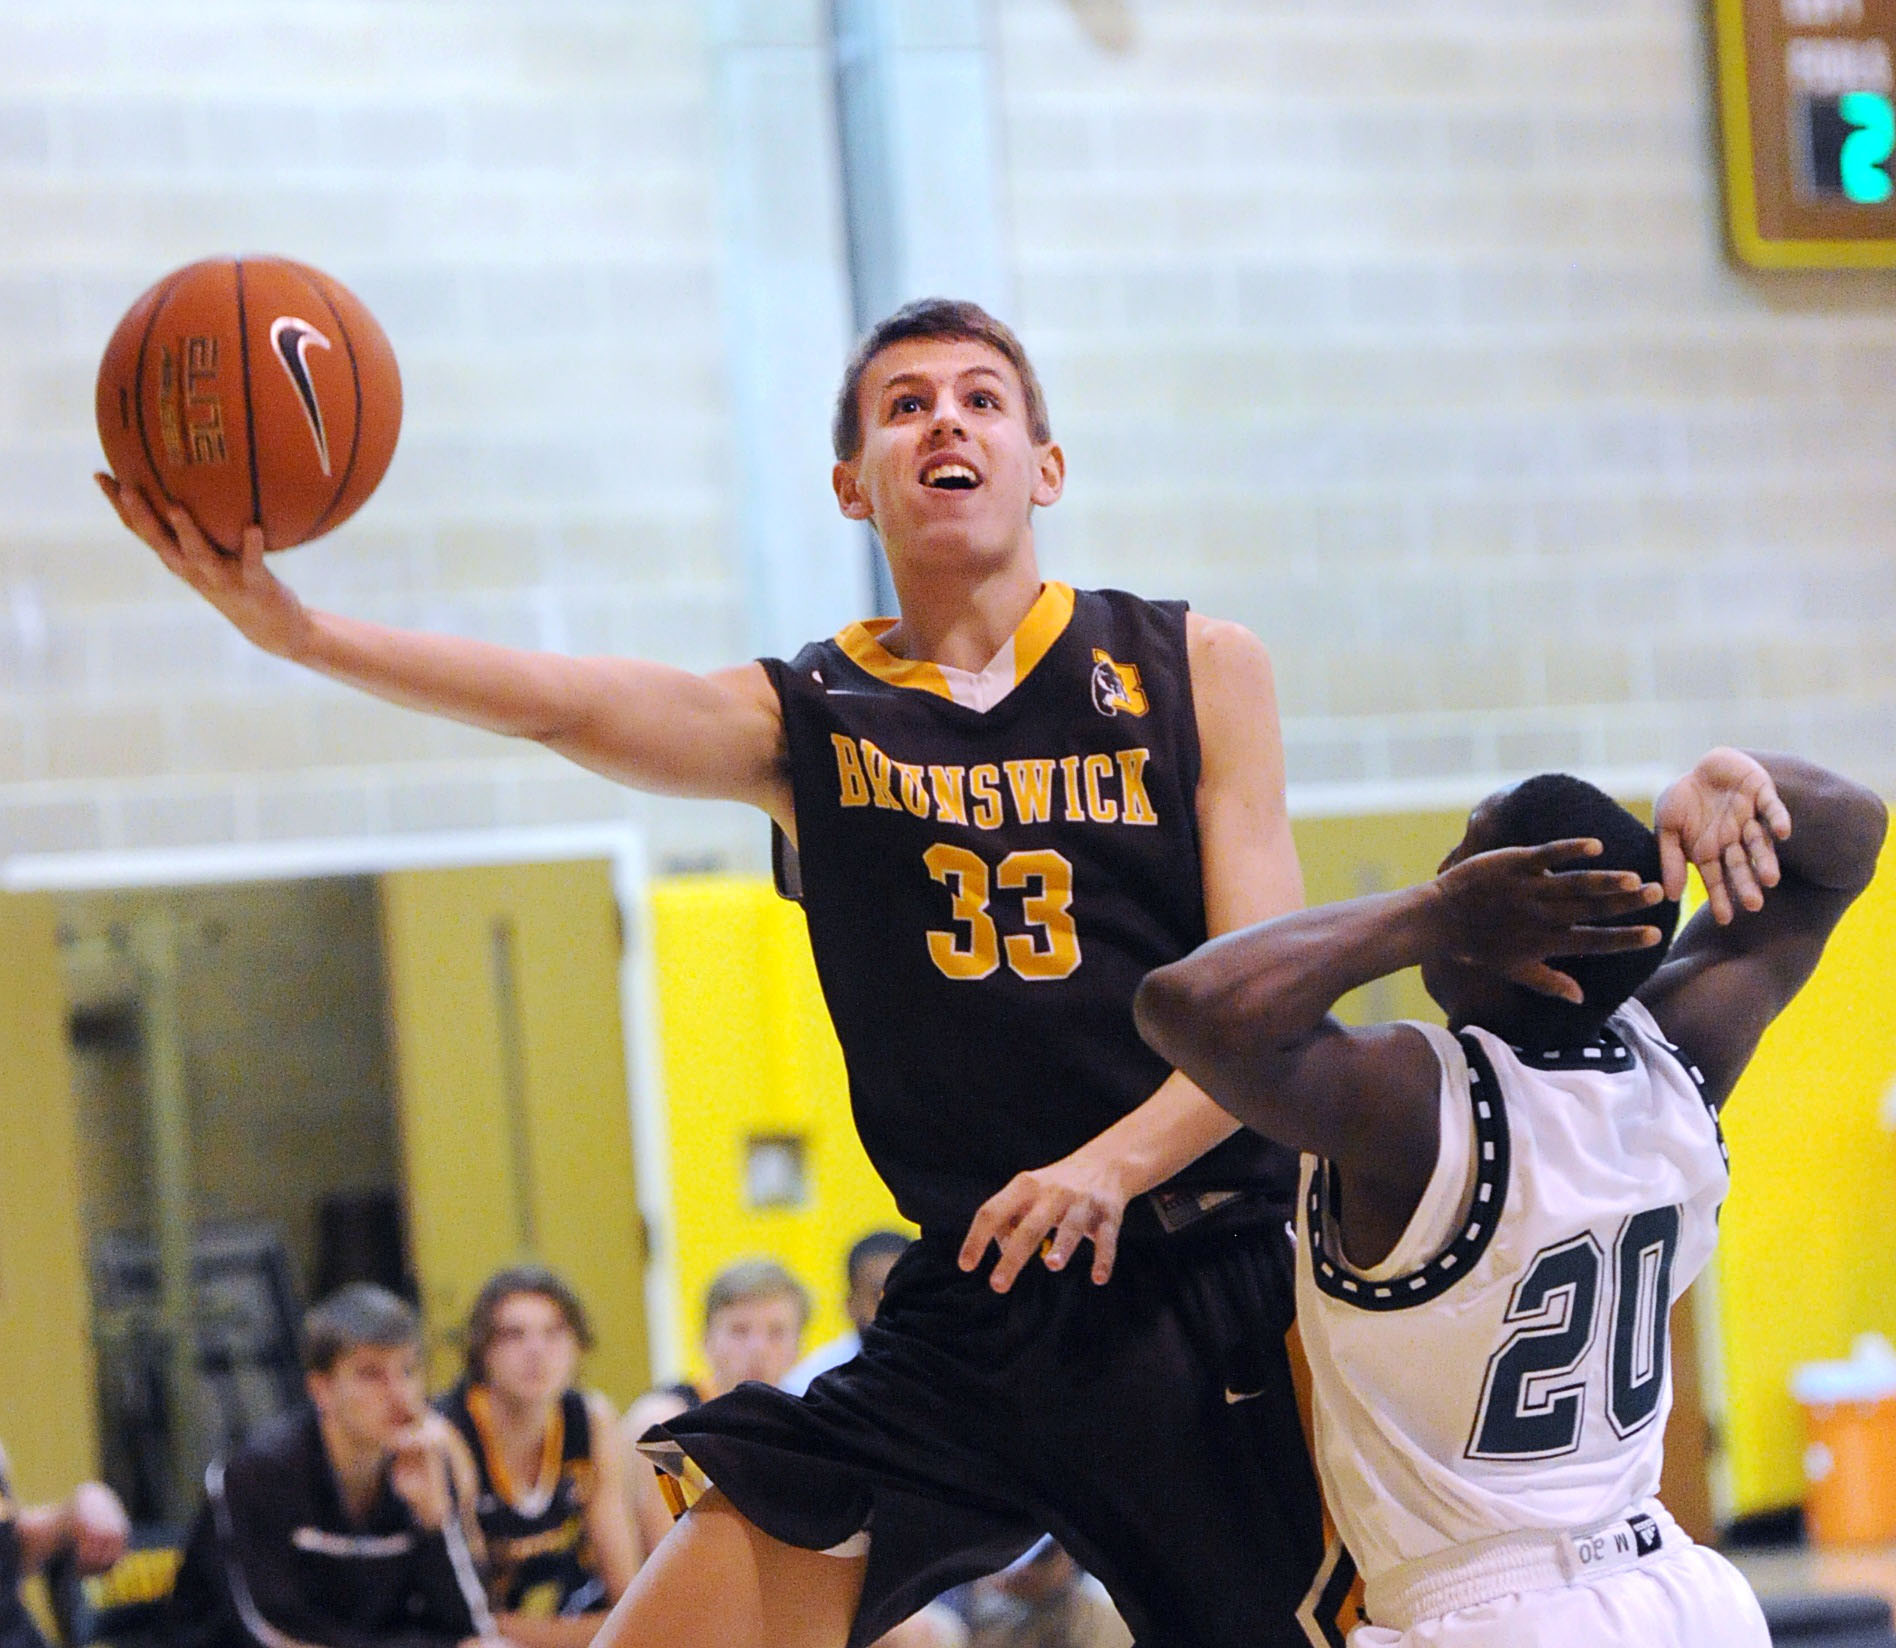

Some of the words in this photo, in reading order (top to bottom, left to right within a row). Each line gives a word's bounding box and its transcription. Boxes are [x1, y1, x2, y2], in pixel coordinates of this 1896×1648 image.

[1838, 91, 1896, 204] 2
[830, 733, 1158, 830] BRUNSWICK
[922, 842, 1082, 981] 33
[1463, 1203, 1684, 1461] 20
[1613, 1532, 1630, 1554] M
